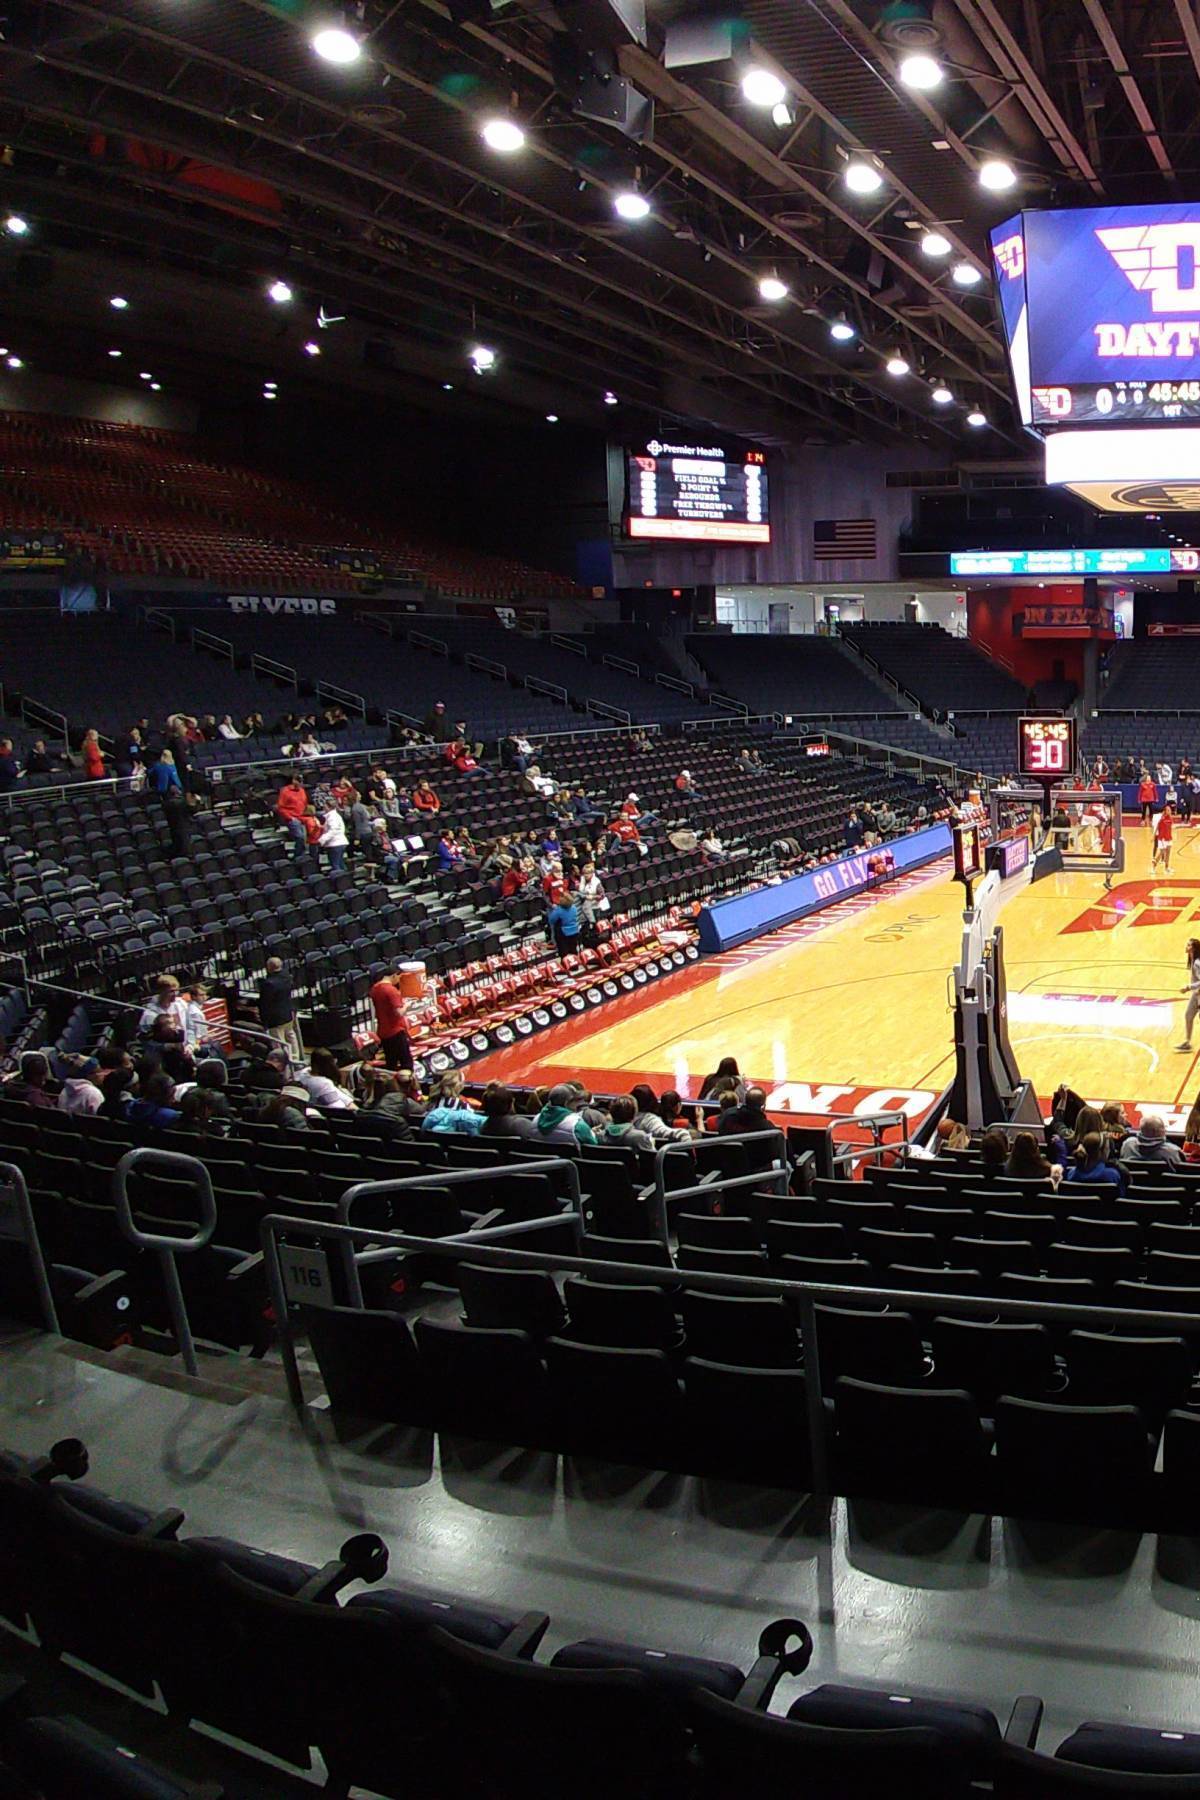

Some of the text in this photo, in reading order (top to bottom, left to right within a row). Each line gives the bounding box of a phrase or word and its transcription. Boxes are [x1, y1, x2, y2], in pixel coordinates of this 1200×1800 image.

[1096, 388, 1113, 414] 0
[1148, 382, 1200, 402] 45:45
[662, 443, 725, 458] Premier Health
[1024, 722, 1069, 741] 45:45
[1031, 740, 1063, 769] 30
[813, 870, 839, 899] GO
[703, 886, 896, 968] UNIVERSITY
[882, 913, 942, 933] PNC
